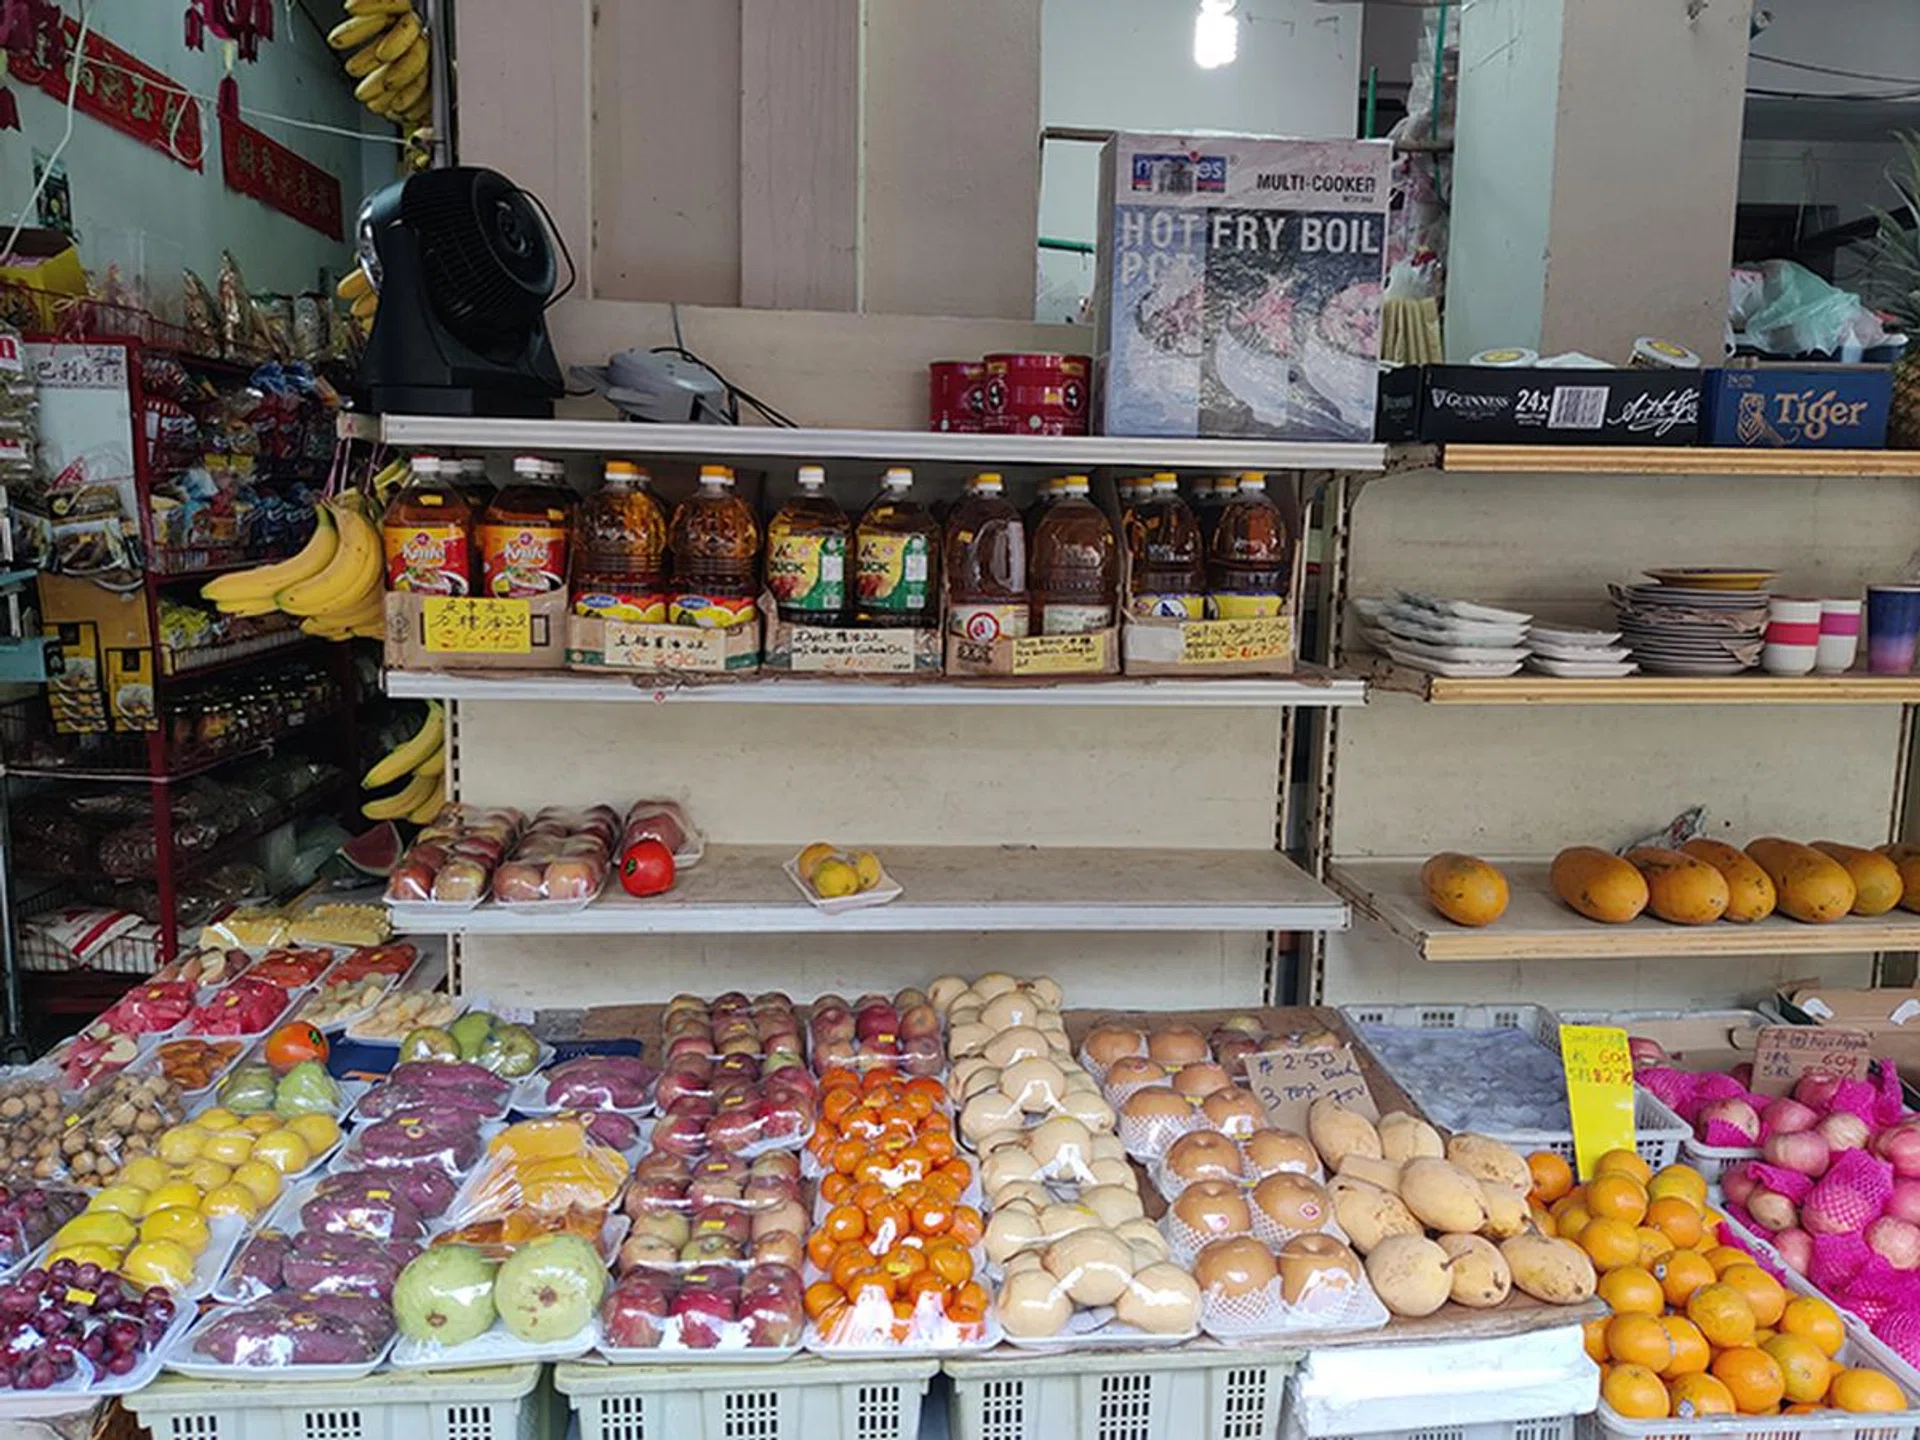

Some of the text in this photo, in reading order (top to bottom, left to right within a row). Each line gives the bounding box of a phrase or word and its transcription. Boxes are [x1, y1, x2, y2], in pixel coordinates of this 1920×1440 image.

[1256, 174, 1376, 193] MULTI-COOKER
[1121, 212, 1380, 254] HOT FRY BOIL
[1773, 389, 1869, 440] Tiger
[1282, 1052, 1336, 1071] 2.50
